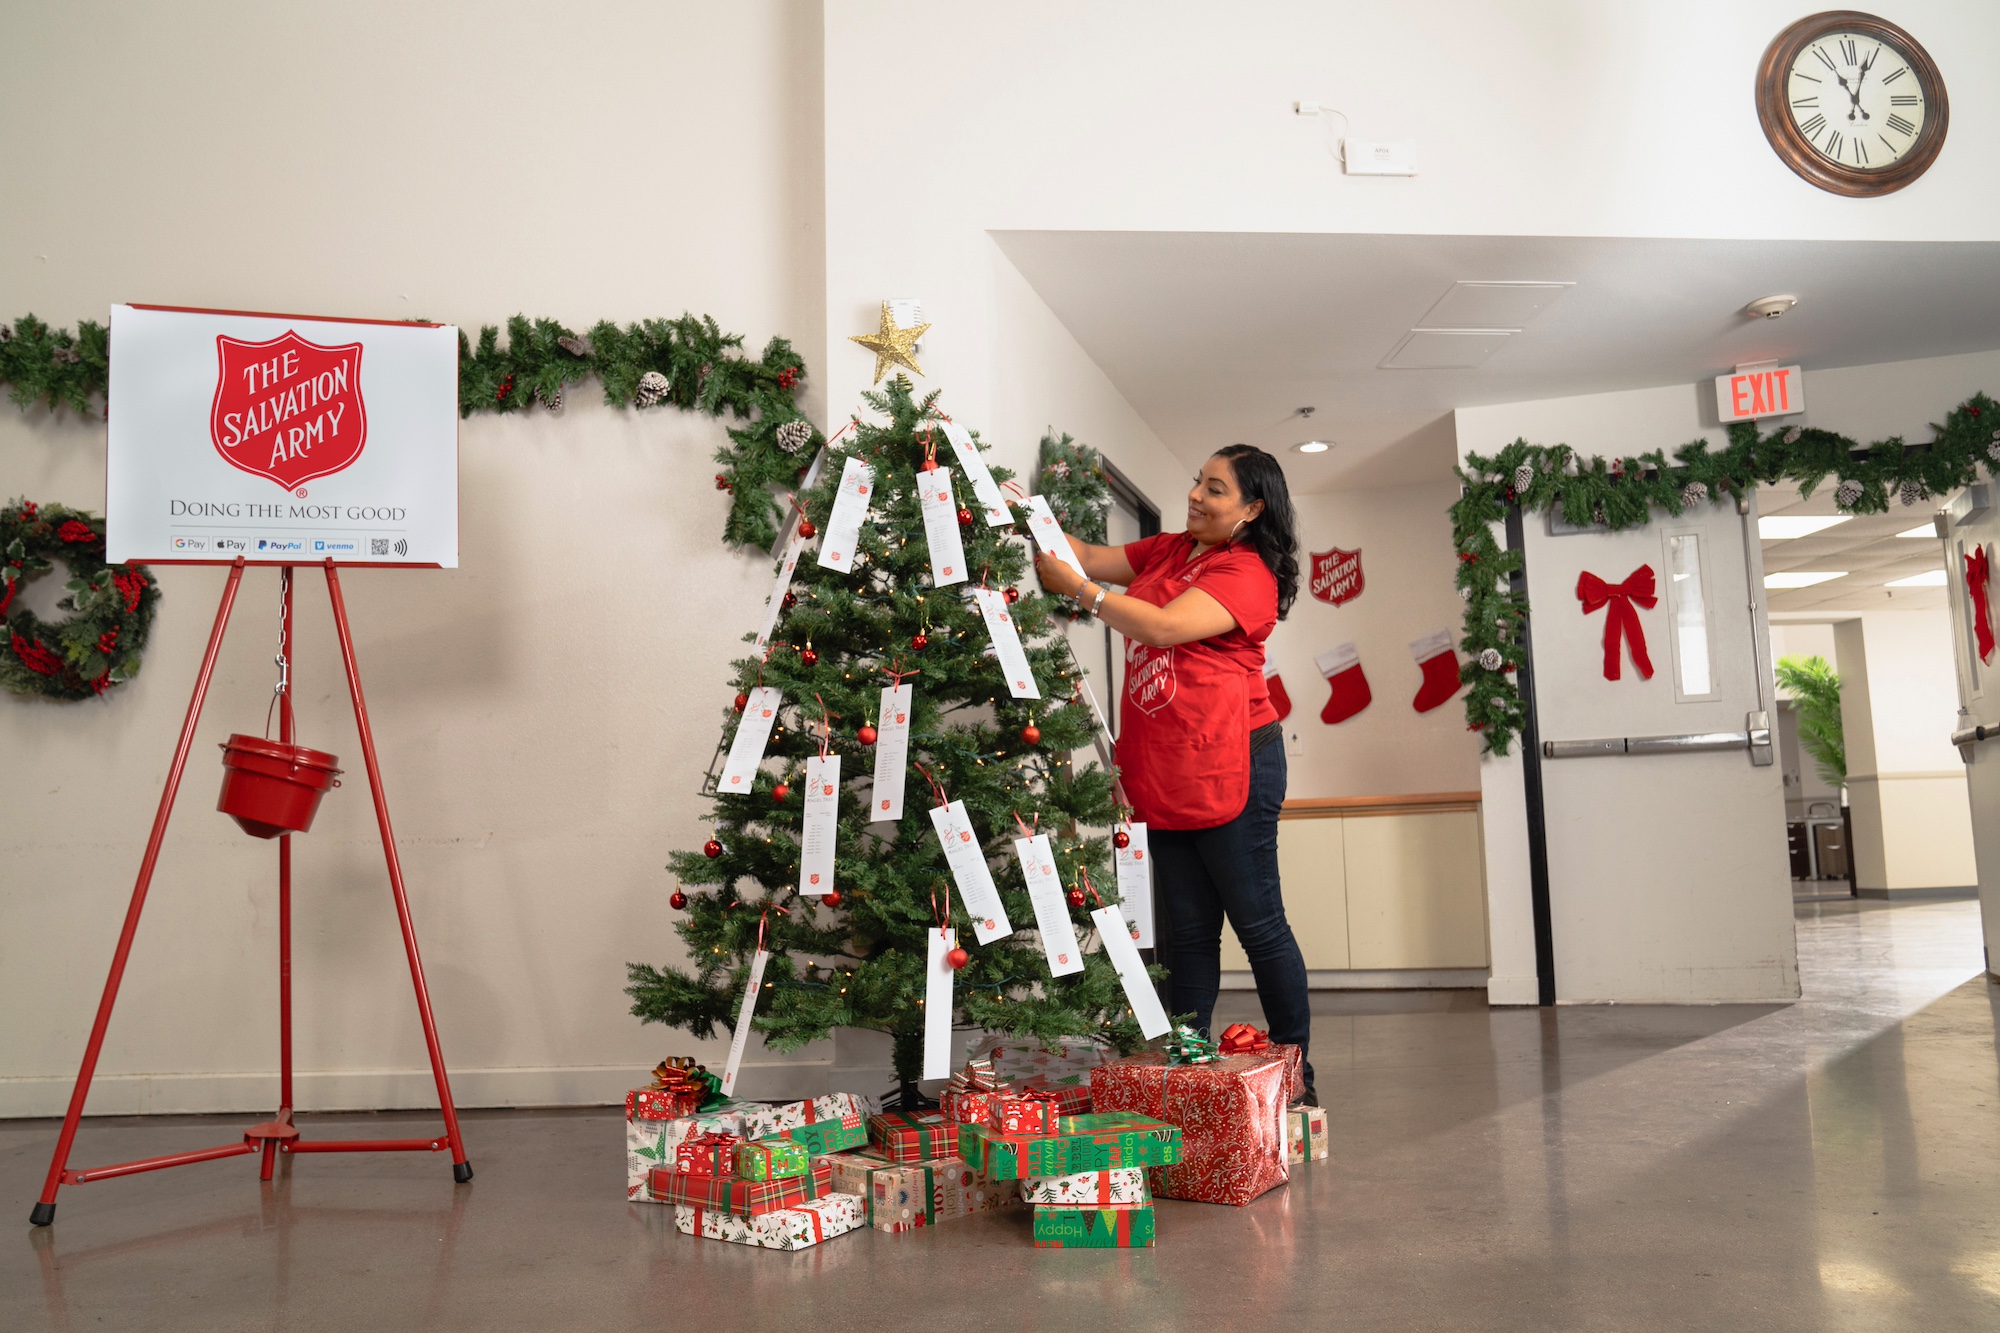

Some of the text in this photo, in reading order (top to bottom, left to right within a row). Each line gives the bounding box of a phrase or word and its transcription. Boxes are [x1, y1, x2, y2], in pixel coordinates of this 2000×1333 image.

[243, 349, 301, 396] THE
[222, 359, 349, 448] SALVATION
[1731, 369, 1790, 417] EXIT
[268, 402, 345, 470] ARMY
[188, 539, 205, 551] Pay
[227, 539, 246, 551] Pay
[270, 541, 302, 551] PayPal
[1312, 554, 1358, 594] SALVATION
[1319, 552, 1340, 574] THE
[1329, 571, 1357, 601] ARMY
[1134, 646, 1149, 669] THE
[946, 1183, 957, 1216] HOPE
[1038, 1223, 1083, 1238] Happy
